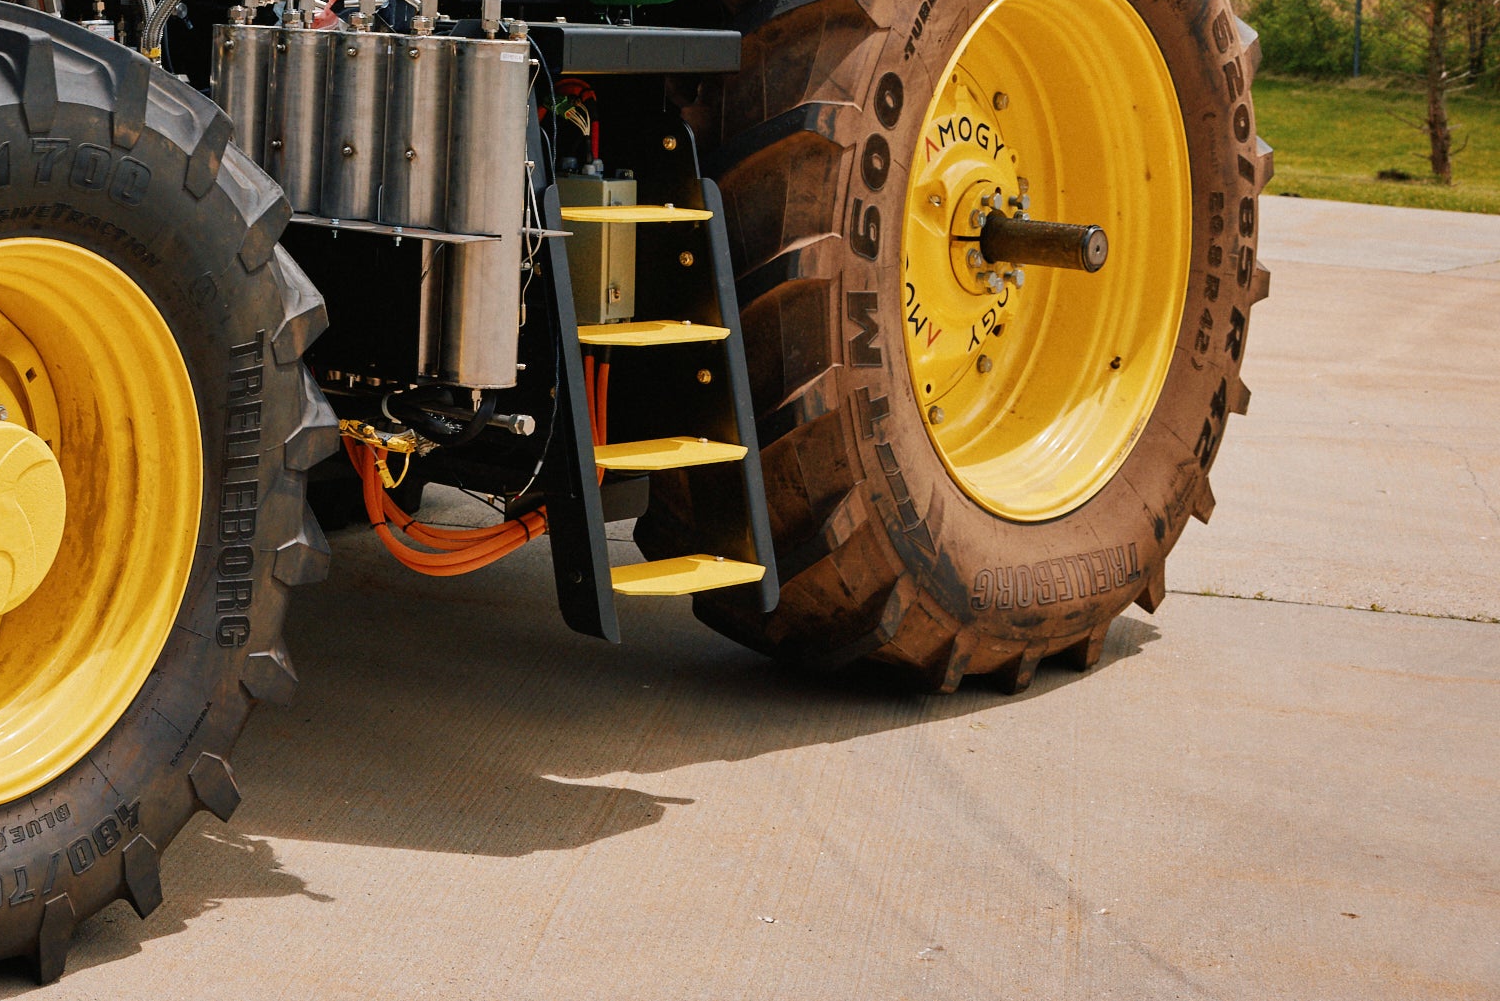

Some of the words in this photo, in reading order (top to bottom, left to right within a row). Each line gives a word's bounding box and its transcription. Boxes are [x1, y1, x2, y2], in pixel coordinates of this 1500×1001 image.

[30, 136, 152, 207] 700
[925, 116, 1005, 163] AMOGY
[214, 327, 267, 648] TRELLEBORG
[970, 541, 1142, 612] TRELLEBORG
